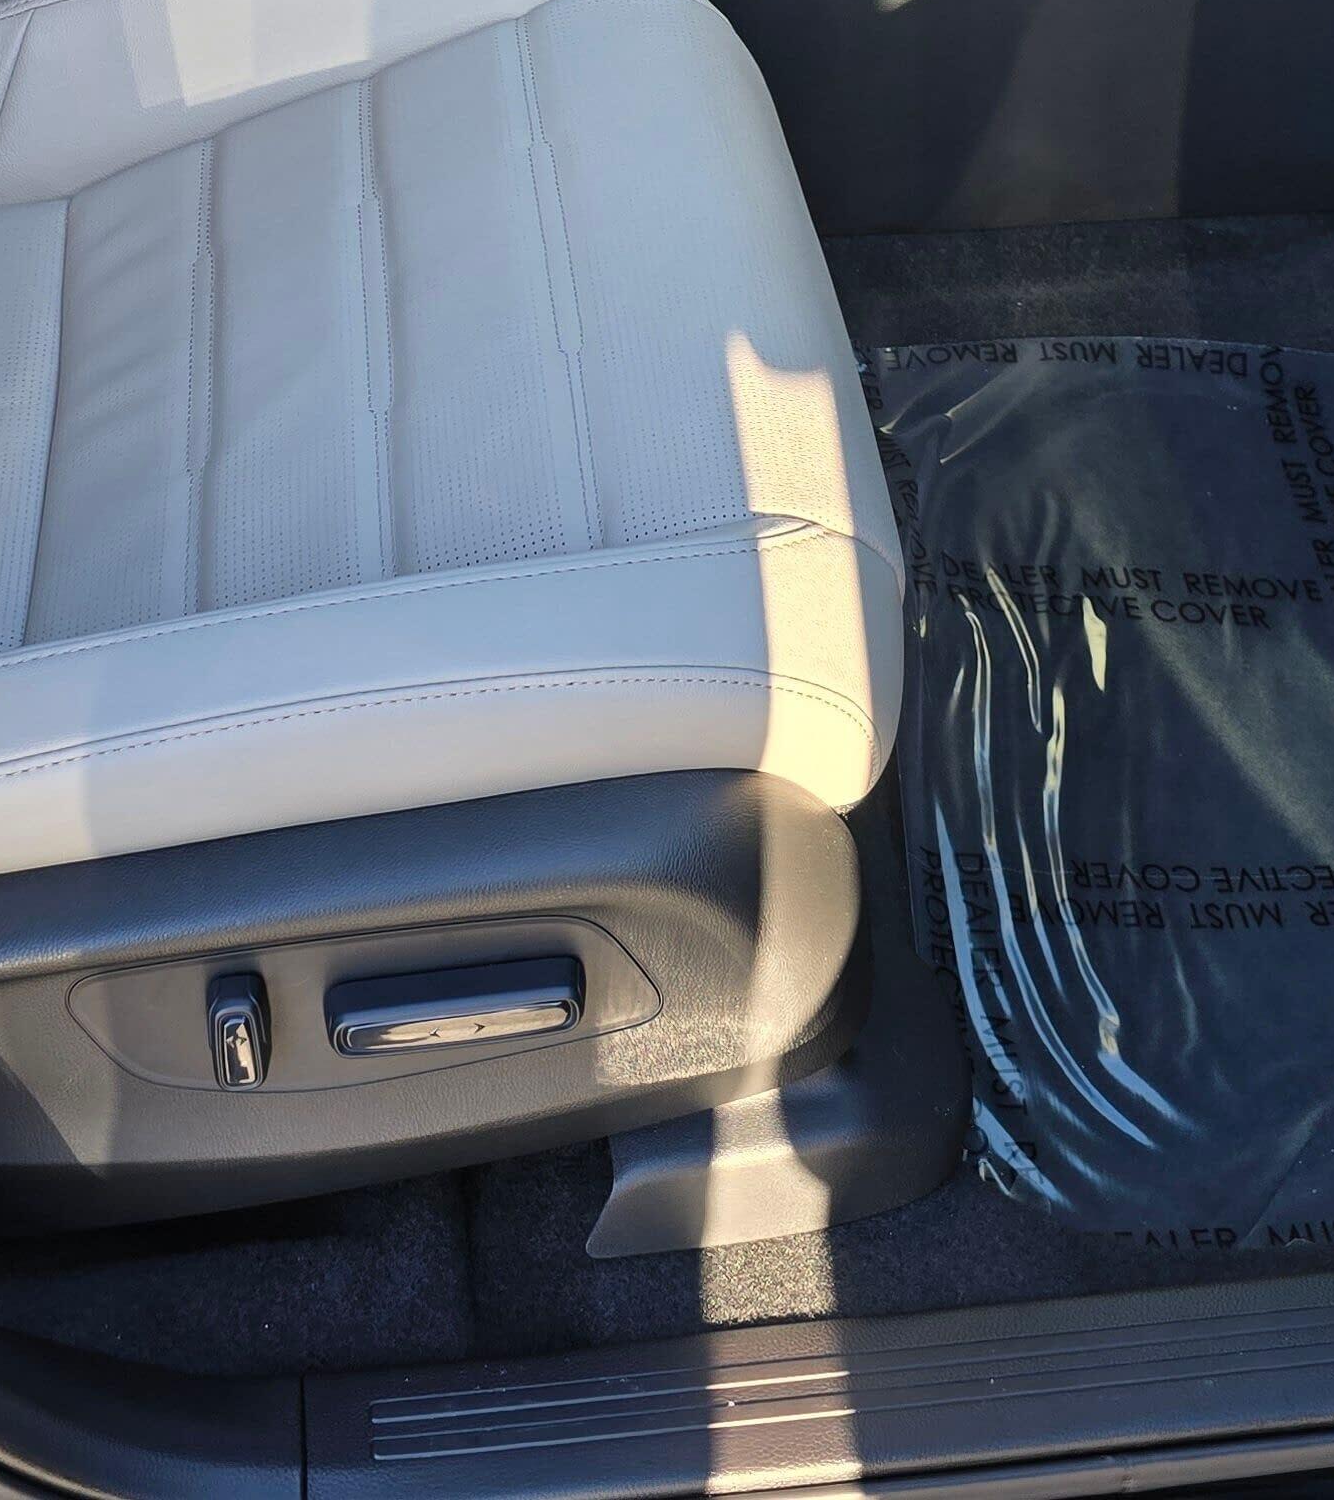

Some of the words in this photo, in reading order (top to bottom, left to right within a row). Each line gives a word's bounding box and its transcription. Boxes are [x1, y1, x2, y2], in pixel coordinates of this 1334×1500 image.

[886, 342, 1019, 373] REMOVE
[1039, 341, 1118, 365] MUST
[1135, 342, 1249, 378] DEALER
[1259, 346, 1298, 445] REMOV
[1281, 458, 1328, 524] MUST
[941, 550, 1060, 587] DEALER
[1080, 565, 1163, 594] MUST
[1182, 570, 1323, 604] REMOVE
[1150, 599, 1272, 630] COVER
[1070, 860, 1201, 893] COVER
[1189, 901, 1282, 930] MUST
